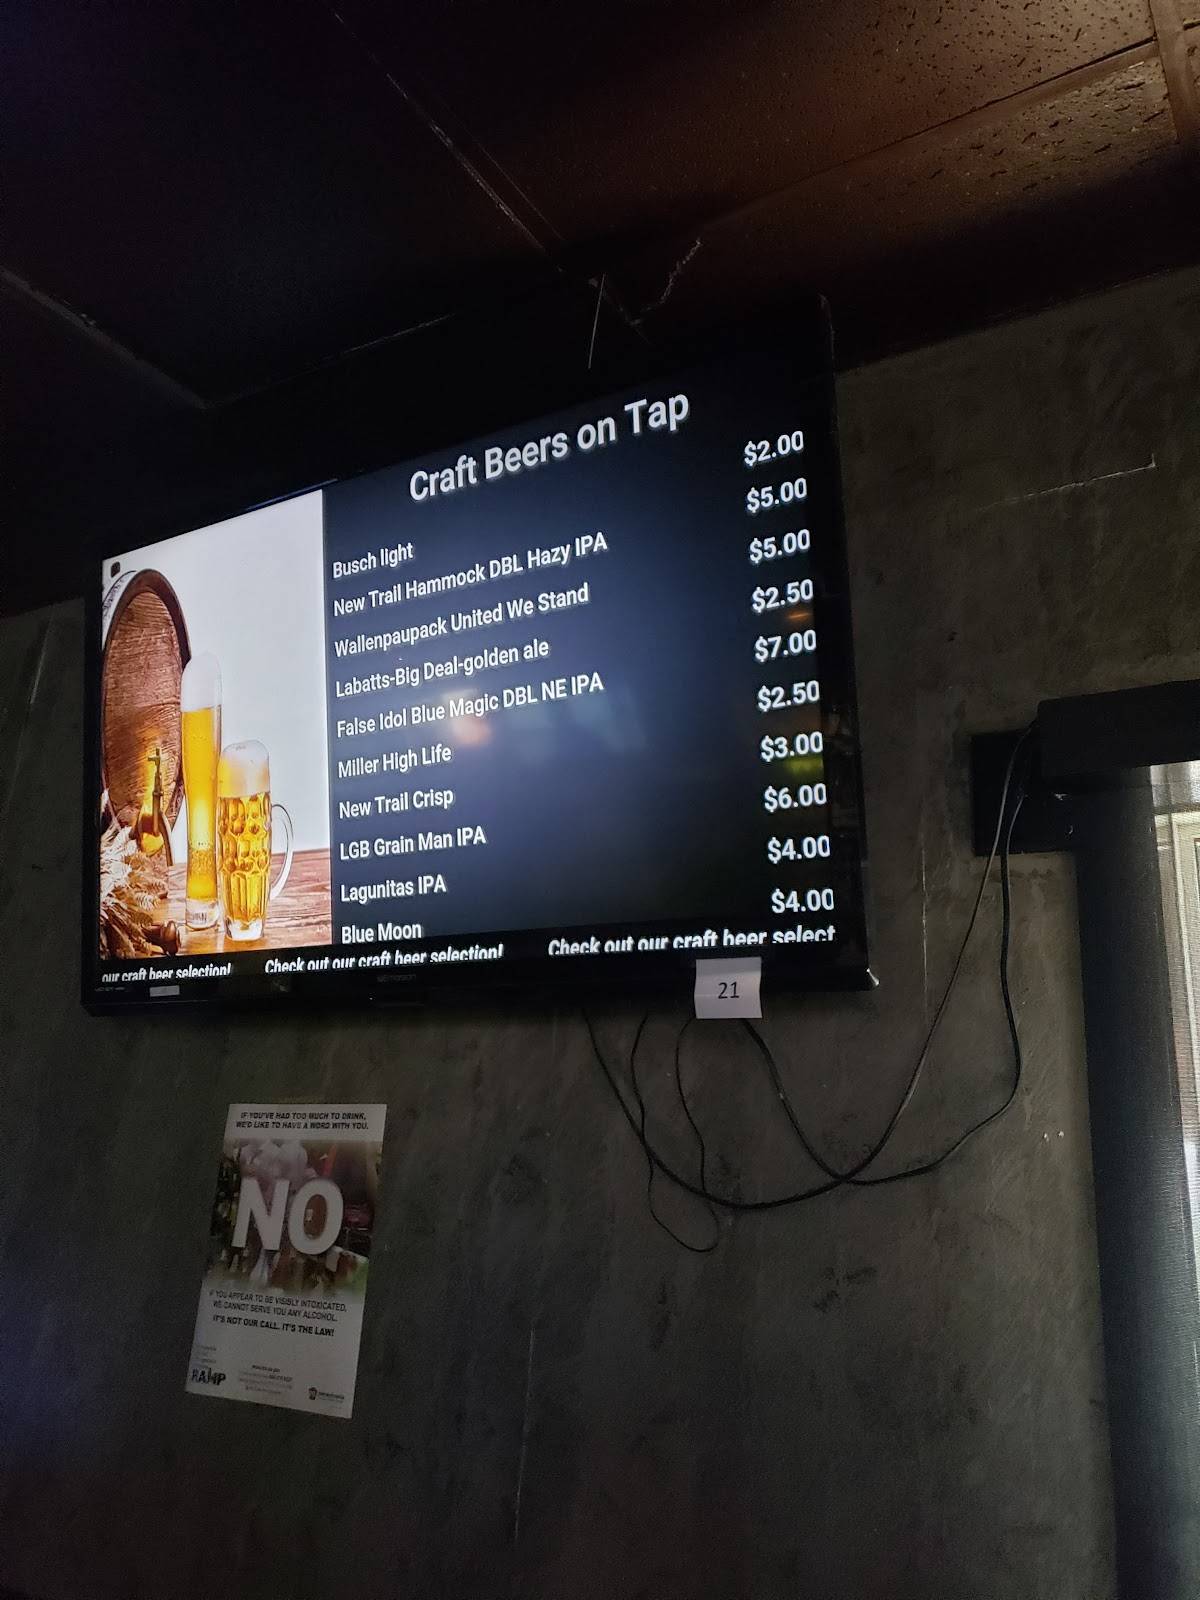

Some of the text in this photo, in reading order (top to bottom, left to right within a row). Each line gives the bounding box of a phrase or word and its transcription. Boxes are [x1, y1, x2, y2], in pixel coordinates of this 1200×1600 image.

[410, 393, 689, 500] Craft Beers on Tap
[744, 430, 804, 466] $2.00
[746, 478, 807, 513] $5.00
[333, 542, 413, 578] Busch light
[749, 529, 811, 564] $5.00
[334, 532, 608, 616] New Trail Hammock DBL Hazy IPA
[752, 579, 814, 613] $2.50
[334, 582, 589, 657] Wallenpaupack United We Stand
[754, 629, 817, 662] $7.00
[336, 638, 549, 697] Labatts-Big Deal-golden ale
[337, 672, 604, 738] False Idol Blue Magic DBL NE IPA
[757, 680, 820, 712] $2.50
[338, 744, 452, 778] Miller High Life
[760, 731, 823, 762] $3.00
[339, 789, 454, 819] New Trail Crisp
[764, 783, 827, 813] $6.00
[340, 826, 486, 860] LGB Grain Man IPA
[767, 836, 830, 864] $4.00
[341, 874, 446, 904] Lagunitas IPA
[771, 888, 834, 914] $4.00
[341, 922, 422, 944] Blue Moon
[717, 981, 740, 999] 21
[231, 1176, 344, 1255] NO
[213, 1314, 335, 1337] IT'S NOT OUR CALL. IT'S THE LAW!
